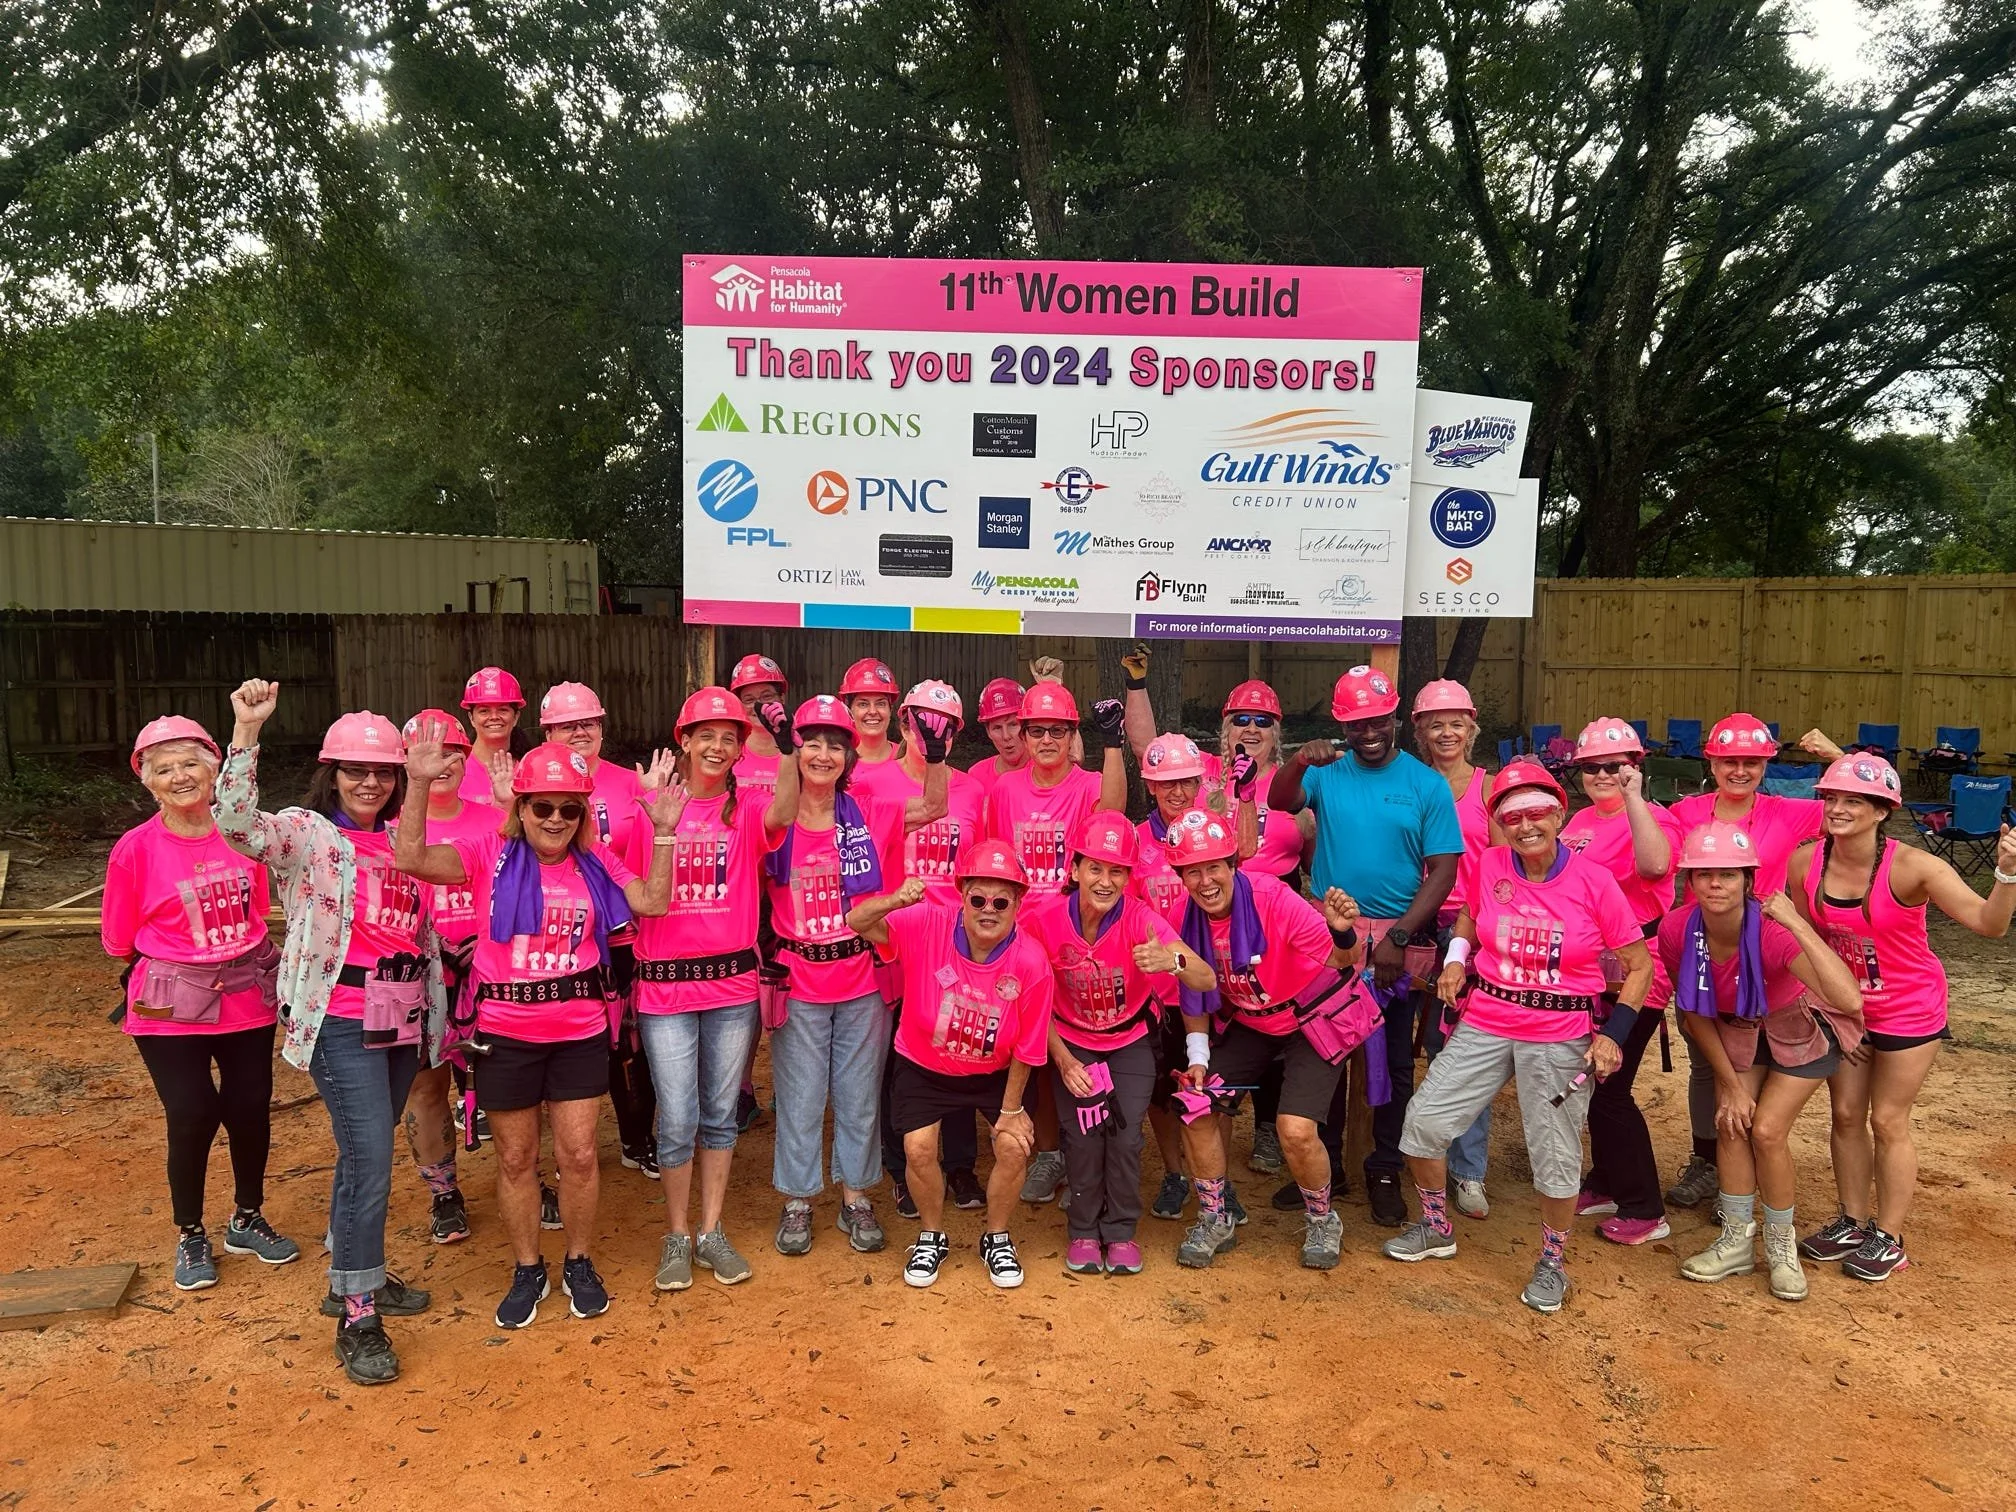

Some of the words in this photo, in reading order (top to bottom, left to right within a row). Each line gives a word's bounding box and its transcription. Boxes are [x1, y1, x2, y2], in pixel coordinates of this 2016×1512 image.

[770, 266, 811, 277] Pensacola
[770, 279, 843, 301] Habitat
[939, 270, 1003, 311] 11th
[1016, 272, 1176, 315] Women
[1190, 275, 1300, 318] Build
[770, 301, 787, 314] for
[727, 337, 874, 380] Thank
[889, 350, 972, 389] you
[990, 344, 1112, 386] 2024
[1129, 346, 1377, 396] Sponsors!
[760, 403, 922, 438] REGIONS
[1482, 416, 1516, 424] PENSACOLA
[987, 424, 1024, 435] Customs
[1091, 410, 1149, 449] HP
[1201, 452, 1283, 484] Gulf
[1283, 454, 1393, 486] Winds
[1067, 473, 1081, 498] E
[856, 477, 948, 514] PNC
[1232, 495, 1293, 509] CREDIT
[1303, 497, 1358, 510] UNION
[1446, 499, 1461, 510] the
[986, 512, 1023, 524] Morgan
[1447, 510, 1484, 521] MKTG
[986, 523, 1023, 536] Stanley
[1446, 521, 1473, 532] BAR
[727, 527, 787, 548] FPL
[1093, 537, 1135, 548] Mathes
[1138, 538, 1175, 551] Group
[1206, 538, 1272, 552] ANCHOR
[777, 568, 833, 584] ORTIZ
[841, 569, 861, 577] LAW
[841, 578, 865, 586] FIRM
[1162, 580, 1207, 597] Flynn
[1182, 594, 1206, 602] Built
[1245, 590, 1285, 599] IRONWORKS
[1418, 592, 1500, 605] SESCO
[1149, 620, 1167, 632] For
[1169, 623, 1198, 633] more
[1200, 622, 1267, 635] information:
[1269, 625, 1387, 639] pensacolahabitat.org
[918, 835, 958, 846] 2024
[677, 842, 727, 854] UILD
[1025, 845, 1064, 854] 2024
[678, 856, 726, 867] 2024
[840, 858, 871, 876] UILD
[202, 892, 249, 913] 2024
[548, 924, 582, 936] 024
[1510, 942, 1560, 958] 2024
[1218, 974, 1257, 984] 2024
[1080, 988, 1124, 999] 2024
[951, 1021, 995, 1043] 2024
